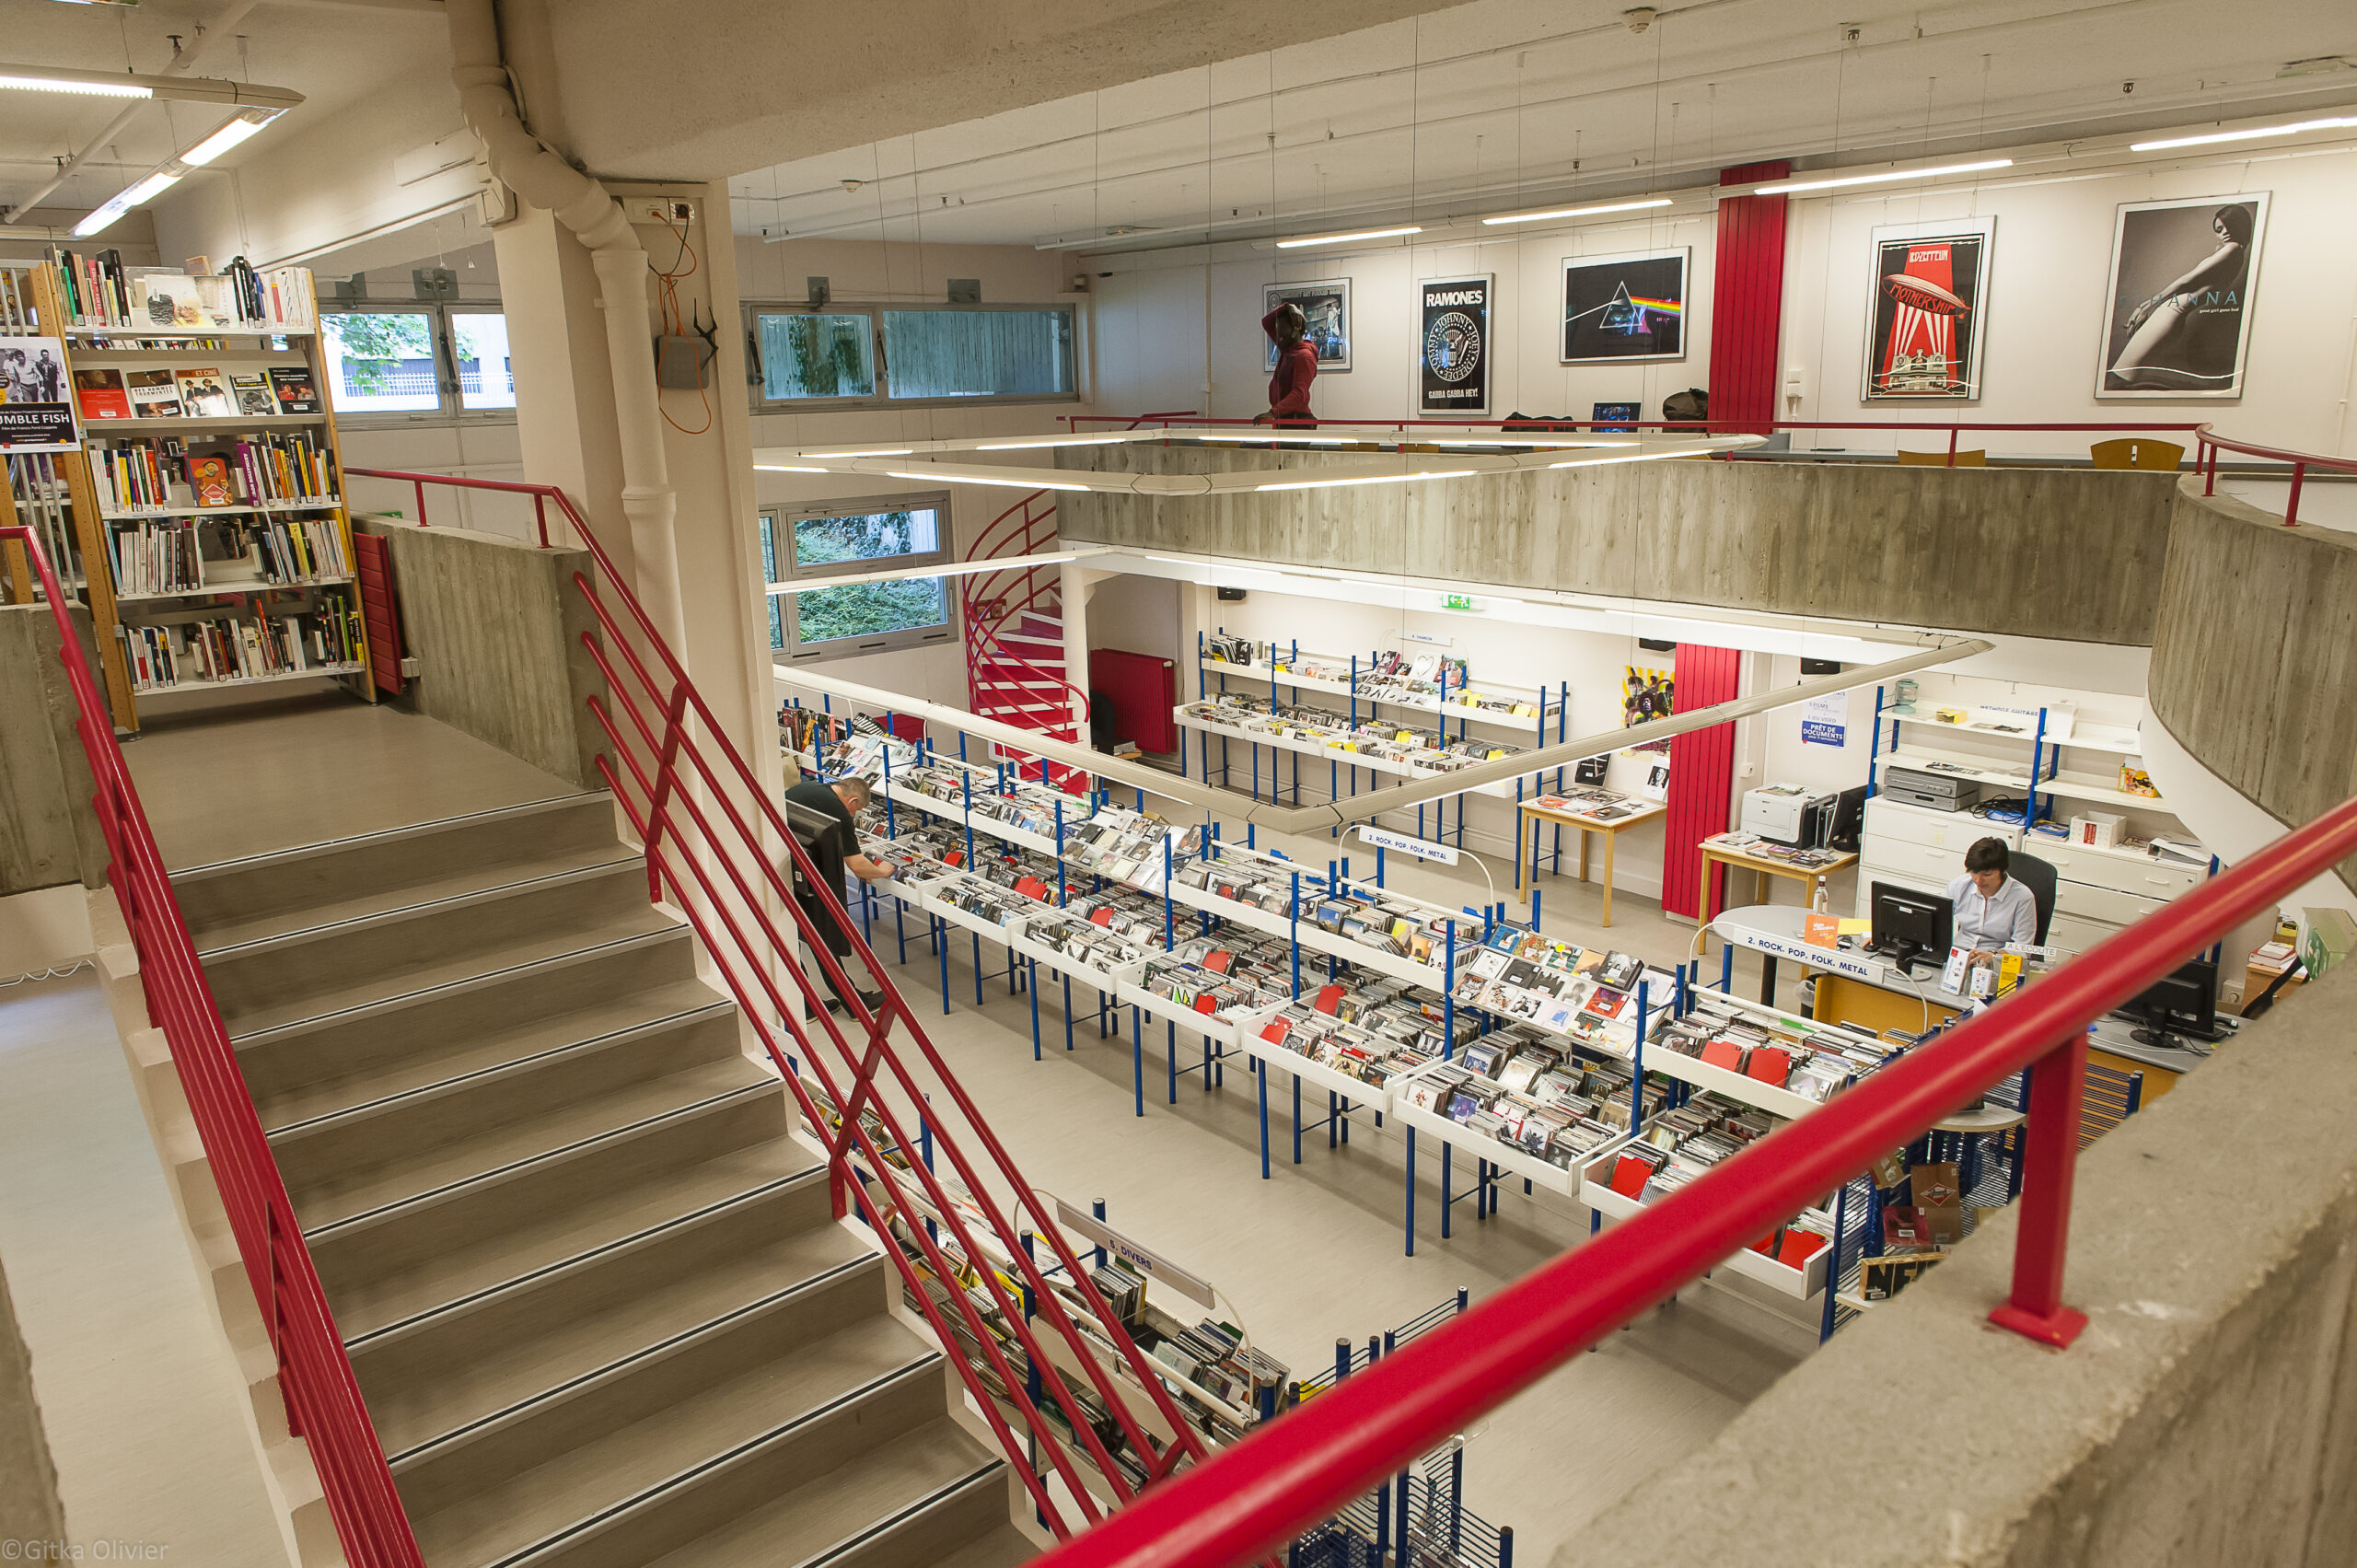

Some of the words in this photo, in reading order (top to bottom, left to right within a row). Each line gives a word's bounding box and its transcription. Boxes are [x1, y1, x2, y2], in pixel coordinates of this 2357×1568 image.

[1426, 290, 1483, 308] RAMONES
[1890, 284, 1956, 314] MOTHERSHIP
[1438, 314, 1470, 330] JOHNNY
[1428, 332, 1441, 371] TOMMY
[1469, 331, 1480, 357] JOEY
[1428, 390, 1446, 399] GABBA
[1446, 389, 1464, 398] GABBA
[1466, 388, 1479, 397] HEY!
[42, 413, 70, 424] FISH
[1803, 728, 1843, 740] DOCUMENTS
[1428, 850, 1447, 860] METAL
[1747, 936, 1755, 945] 2.
[1839, 961, 1868, 976] METAL
[2015, 944, 2055, 956] L'ECOUTE
[1120, 1245, 1152, 1271] DIVERS
